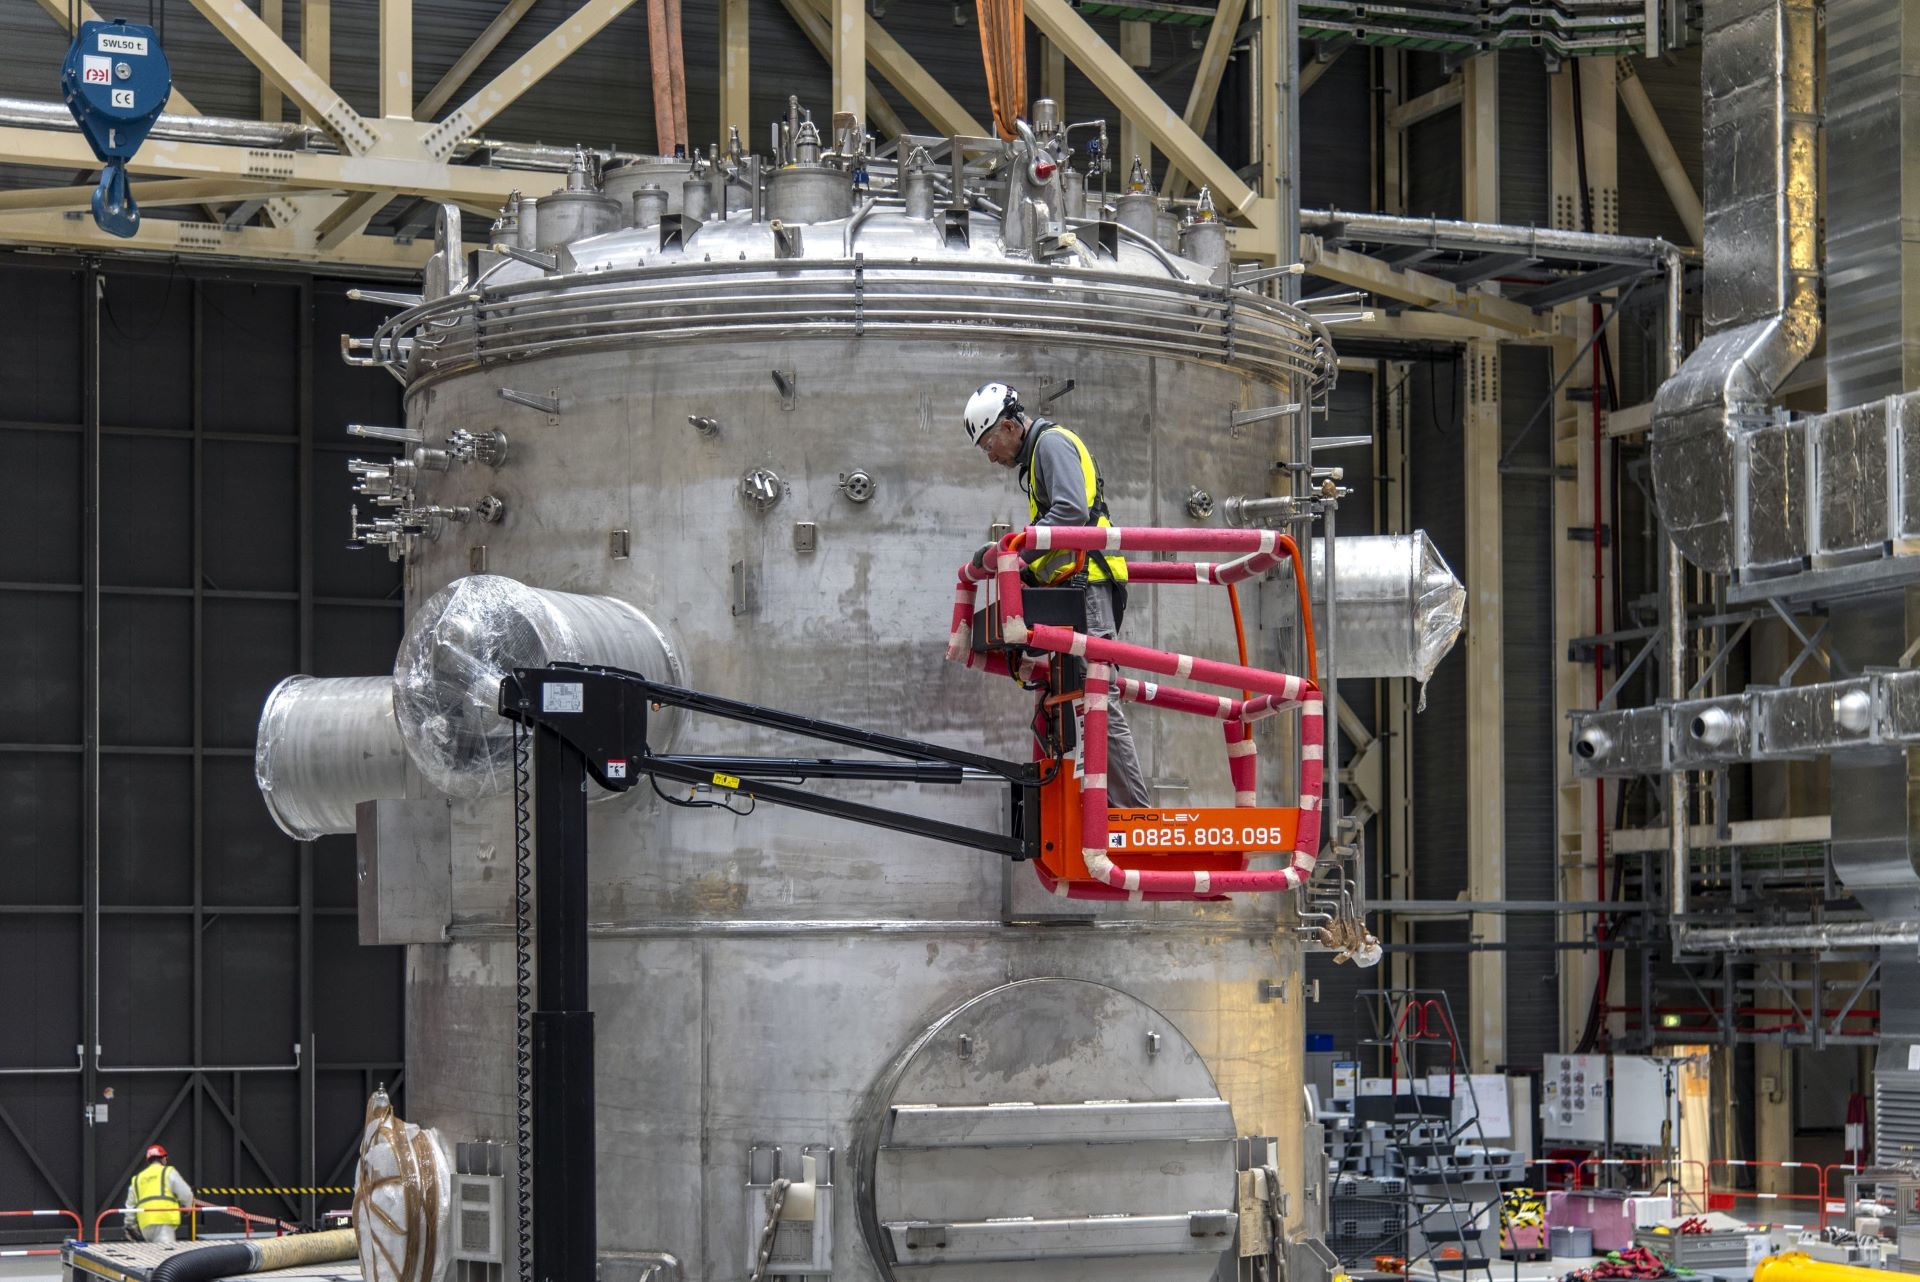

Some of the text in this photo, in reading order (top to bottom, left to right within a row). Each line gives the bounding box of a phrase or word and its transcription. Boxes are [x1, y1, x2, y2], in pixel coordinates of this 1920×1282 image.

[86, 68, 109, 82] reel
[115, 93, 131, 105] CE
[1132, 827, 1281, 846] 0825.803.095
